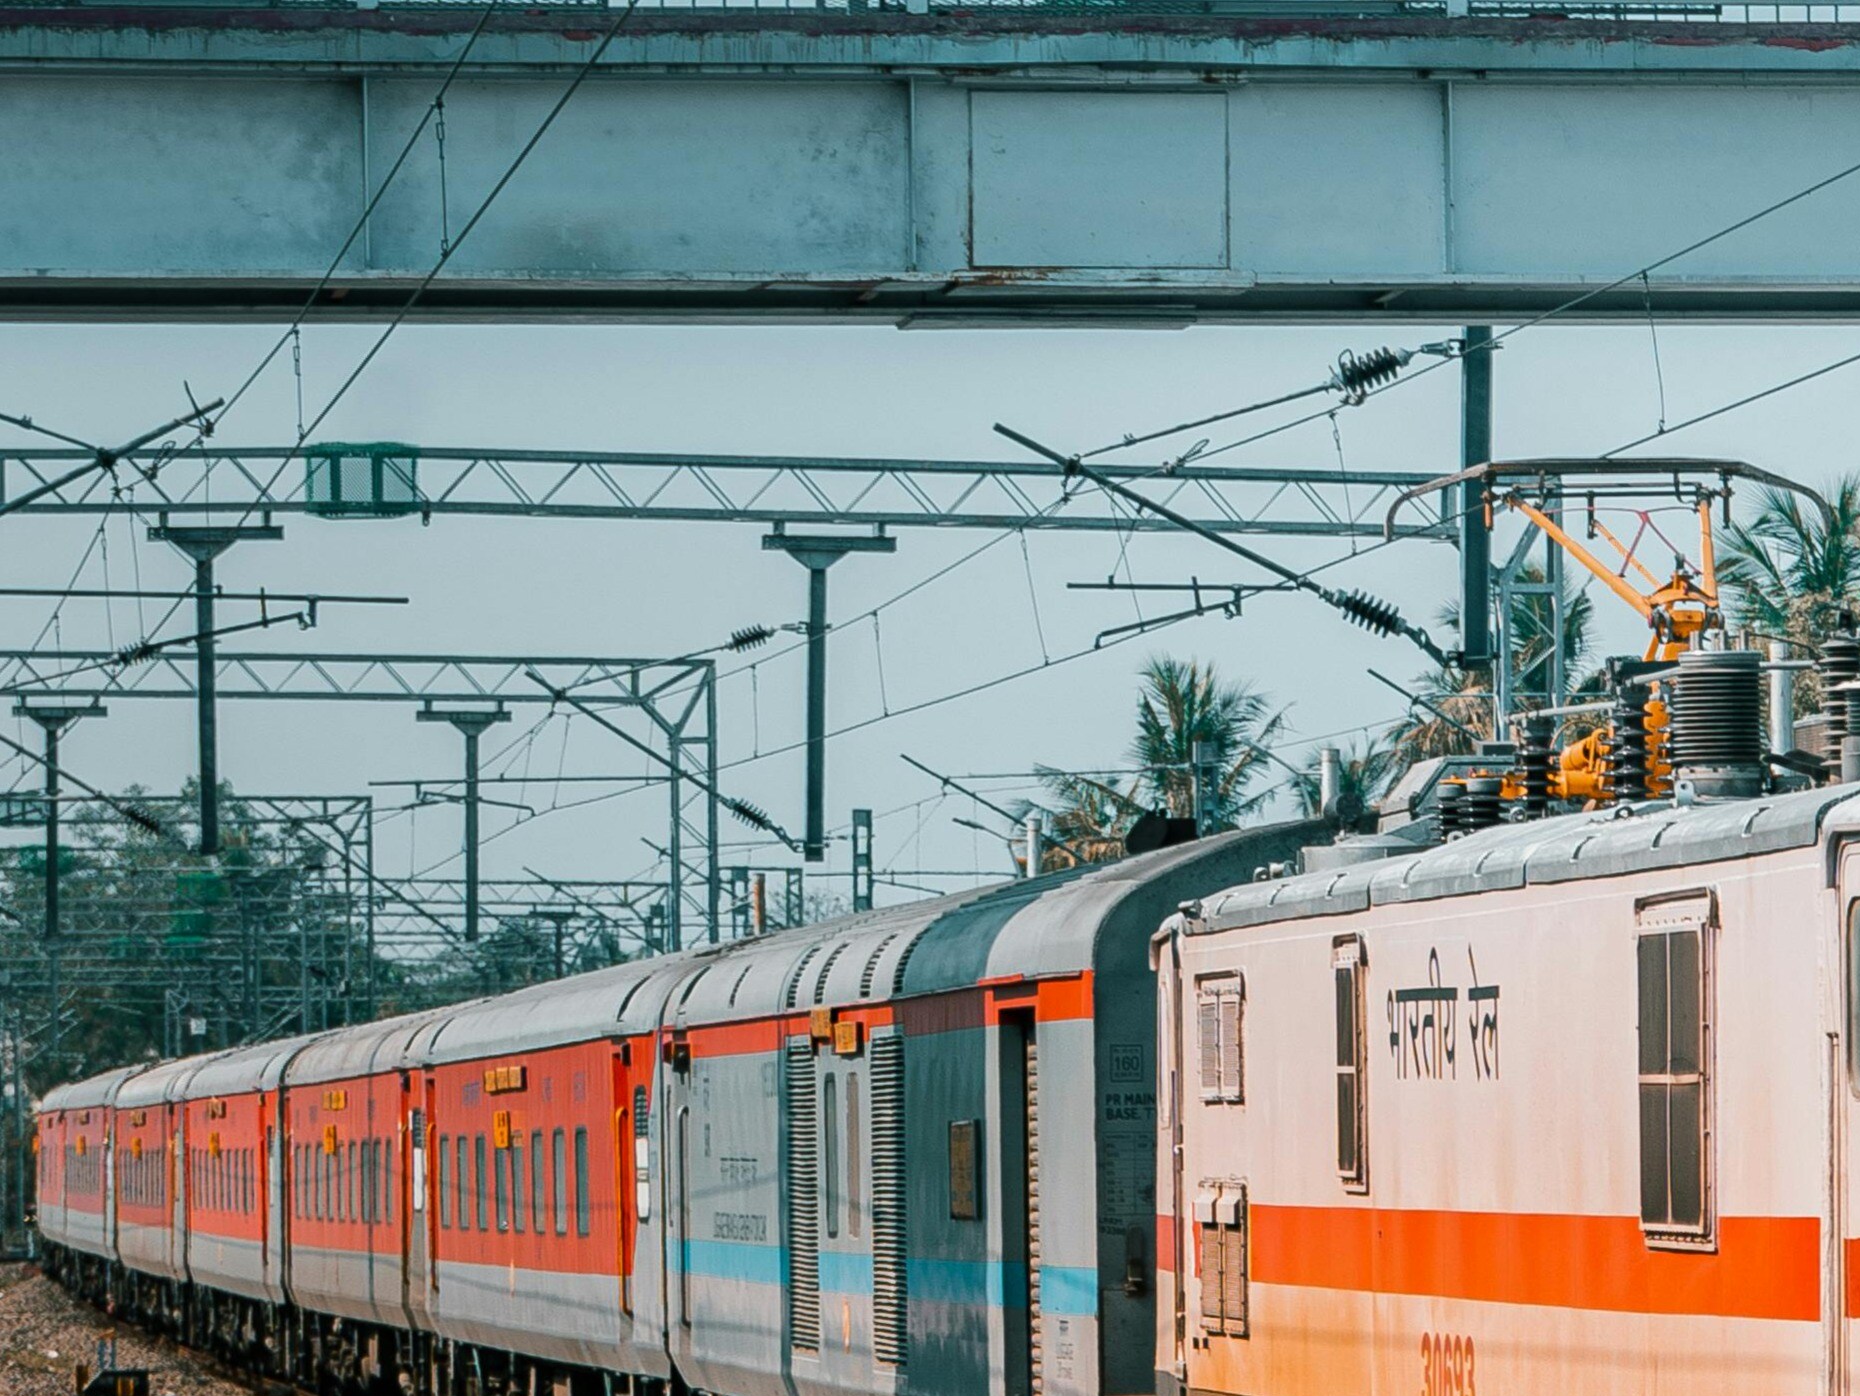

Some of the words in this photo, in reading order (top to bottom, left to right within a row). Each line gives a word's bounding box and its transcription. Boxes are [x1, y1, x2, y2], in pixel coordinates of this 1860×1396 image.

[1387, 945, 1458, 1080] भारतीय
[1467, 941, 1500, 1082] रेल
[1113, 1056, 1140, 1071] 160
